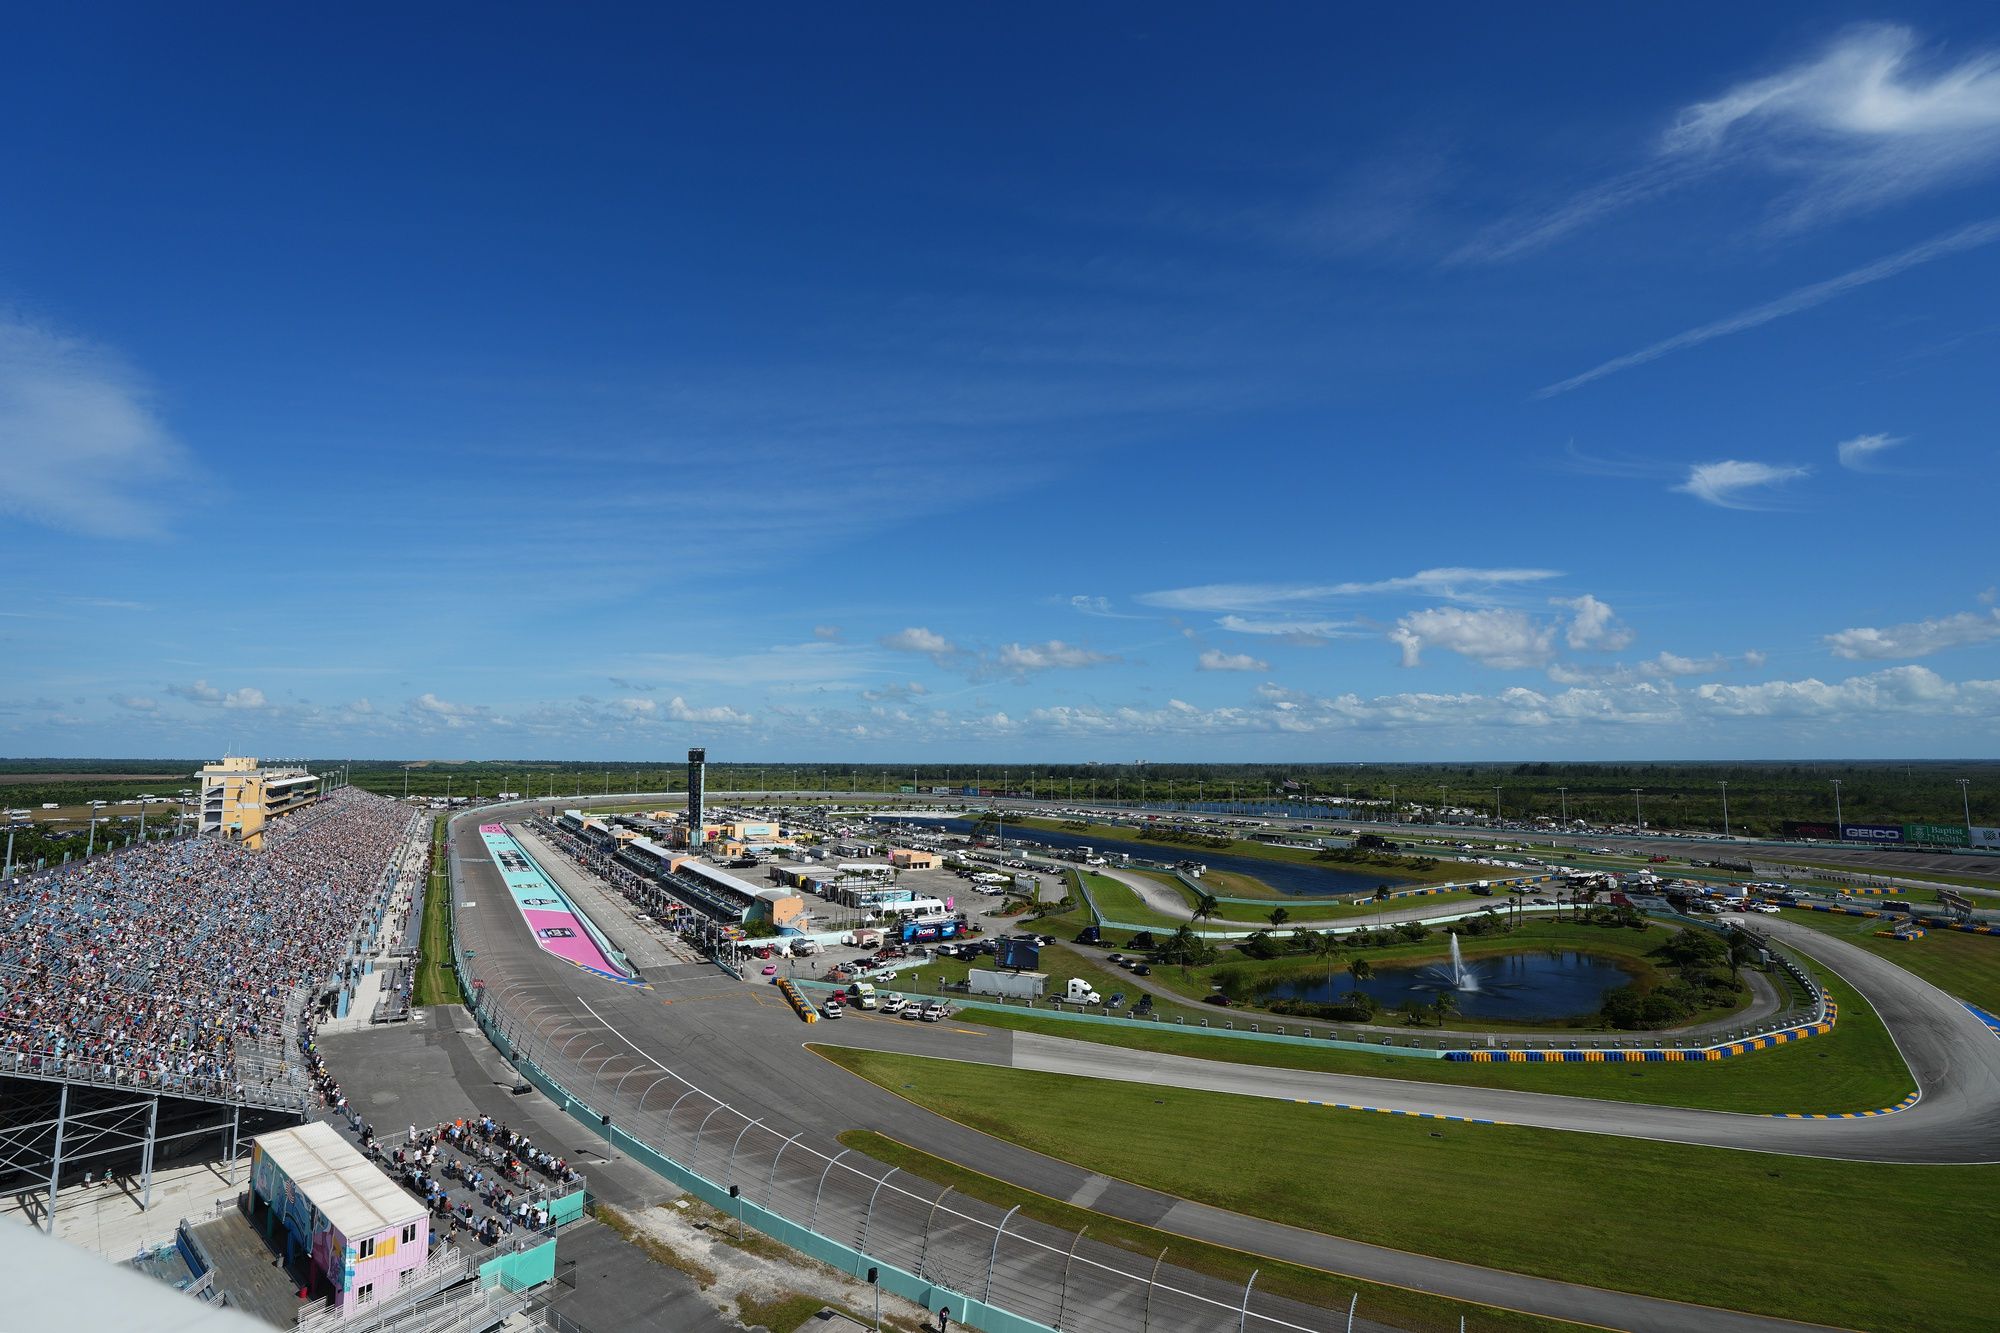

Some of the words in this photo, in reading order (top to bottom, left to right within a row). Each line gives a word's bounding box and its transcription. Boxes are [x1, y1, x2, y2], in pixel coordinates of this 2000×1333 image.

[1846, 828, 1899, 839] GEICO
[1931, 826, 1963, 835] Baptist
[1931, 834, 1962, 843] Health
